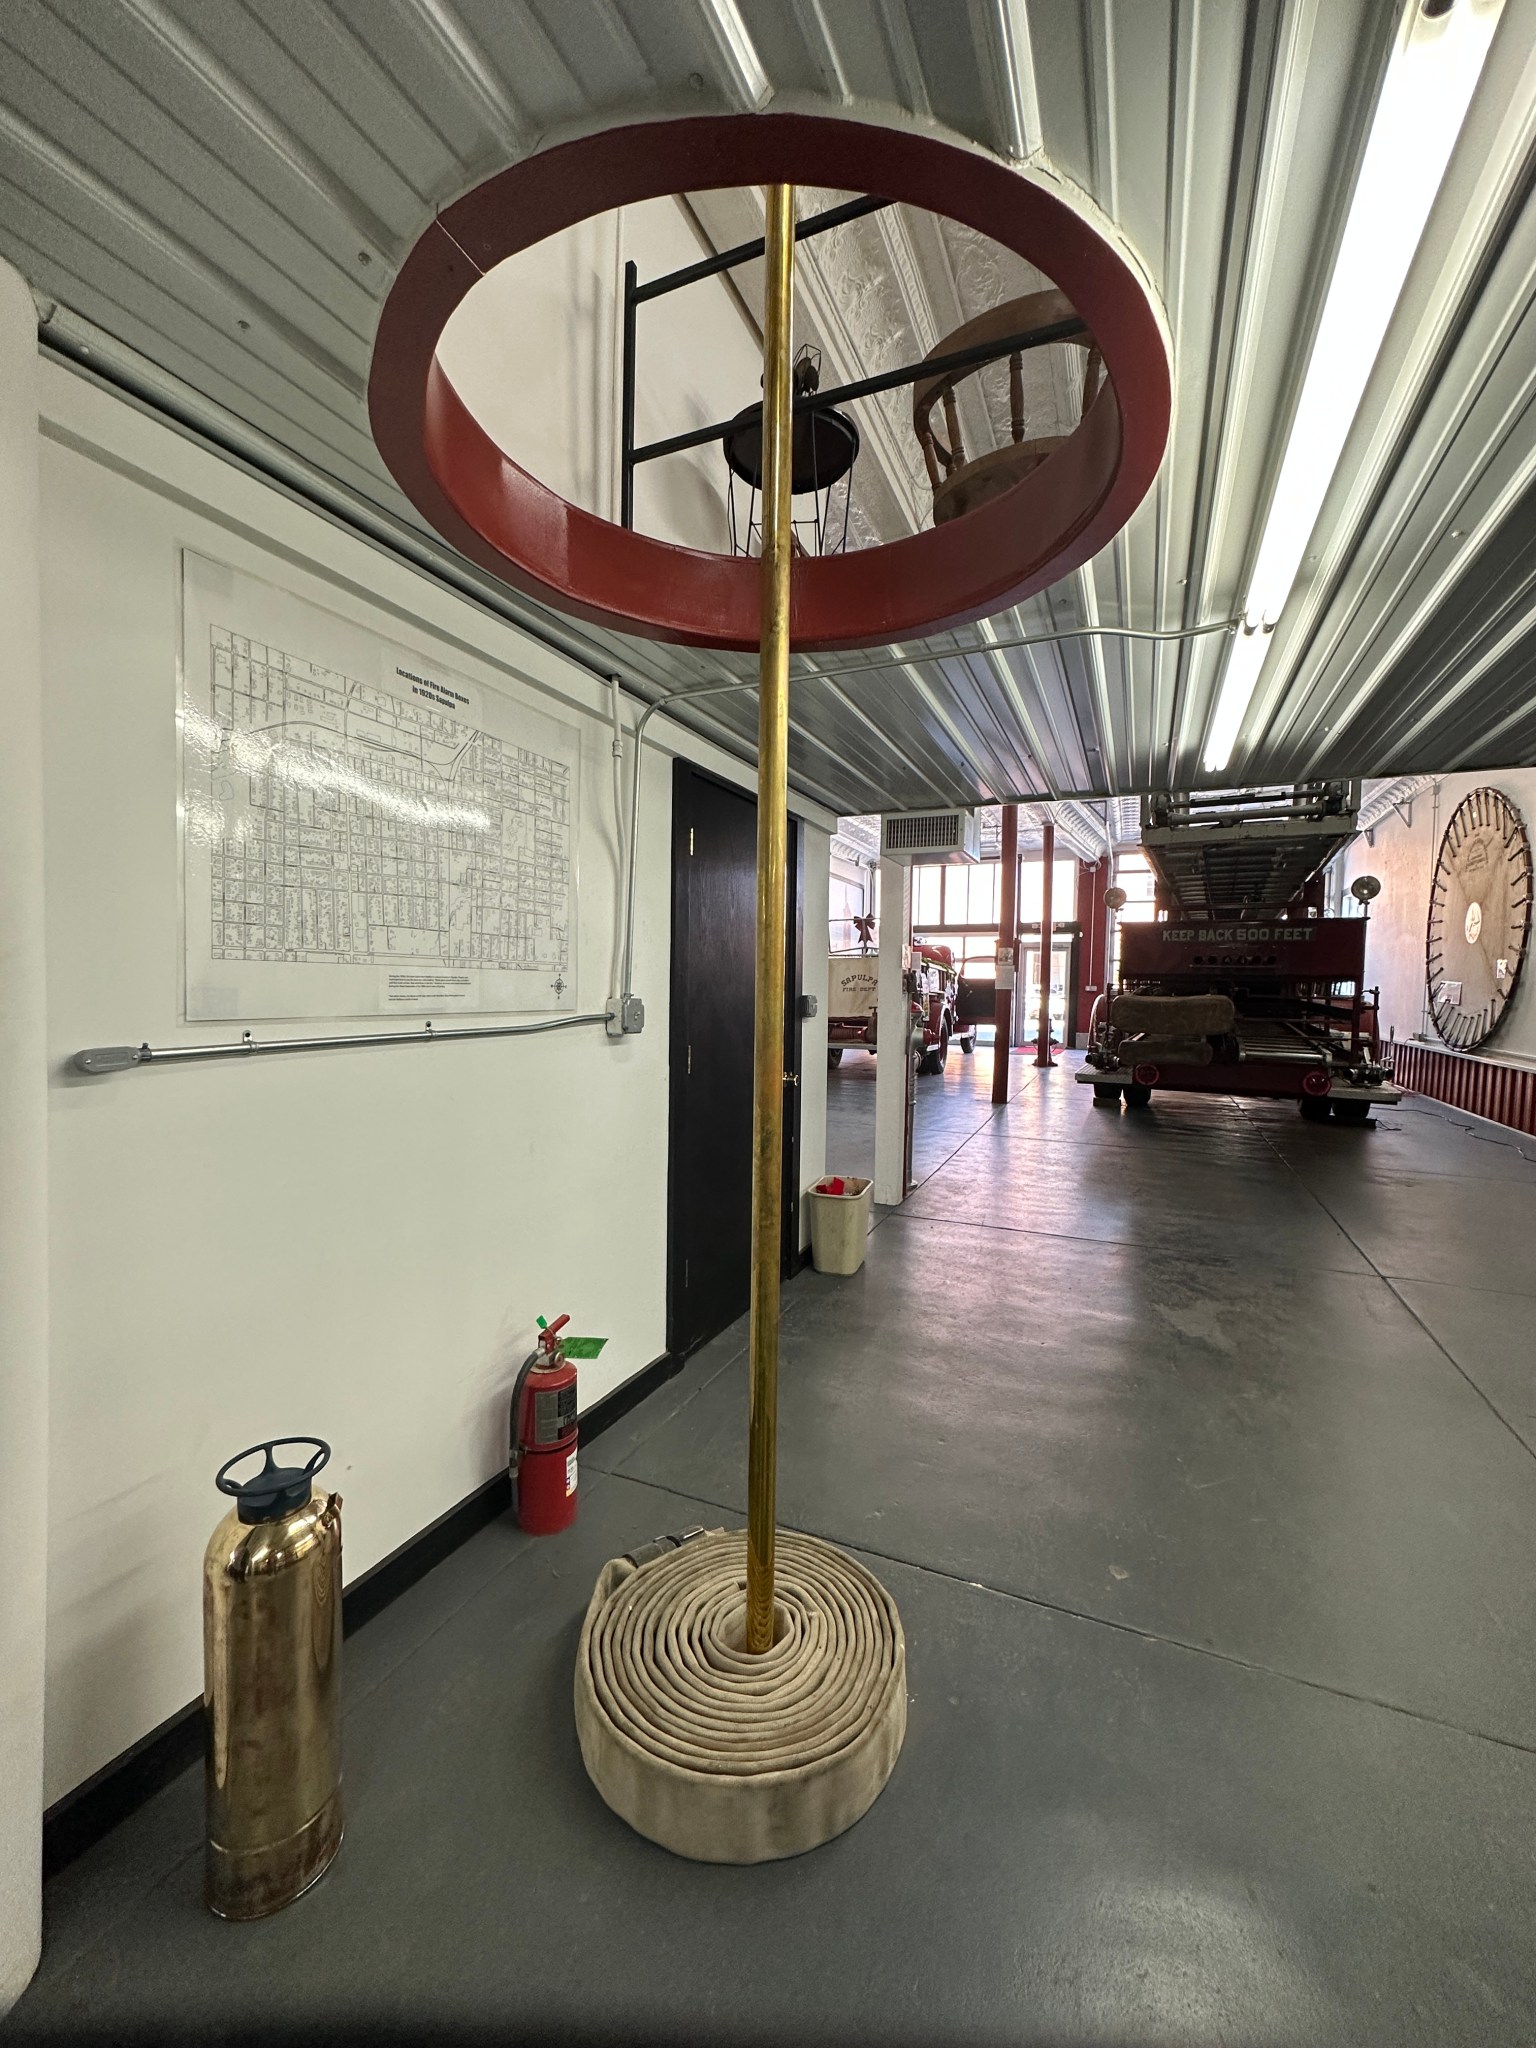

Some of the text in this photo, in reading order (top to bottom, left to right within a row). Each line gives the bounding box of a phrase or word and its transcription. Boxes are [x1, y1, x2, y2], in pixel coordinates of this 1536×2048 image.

[396, 667, 422, 684] Locations
[430, 681, 439, 691] Fire
[441, 686, 454, 698] Alarm
[455, 693, 469, 704] Boxes
[419, 689, 435, 700] 1920s
[1162, 927, 1313, 942] KEEP BACK 500 FEET
[841, 974, 878, 986] SAPULPA
